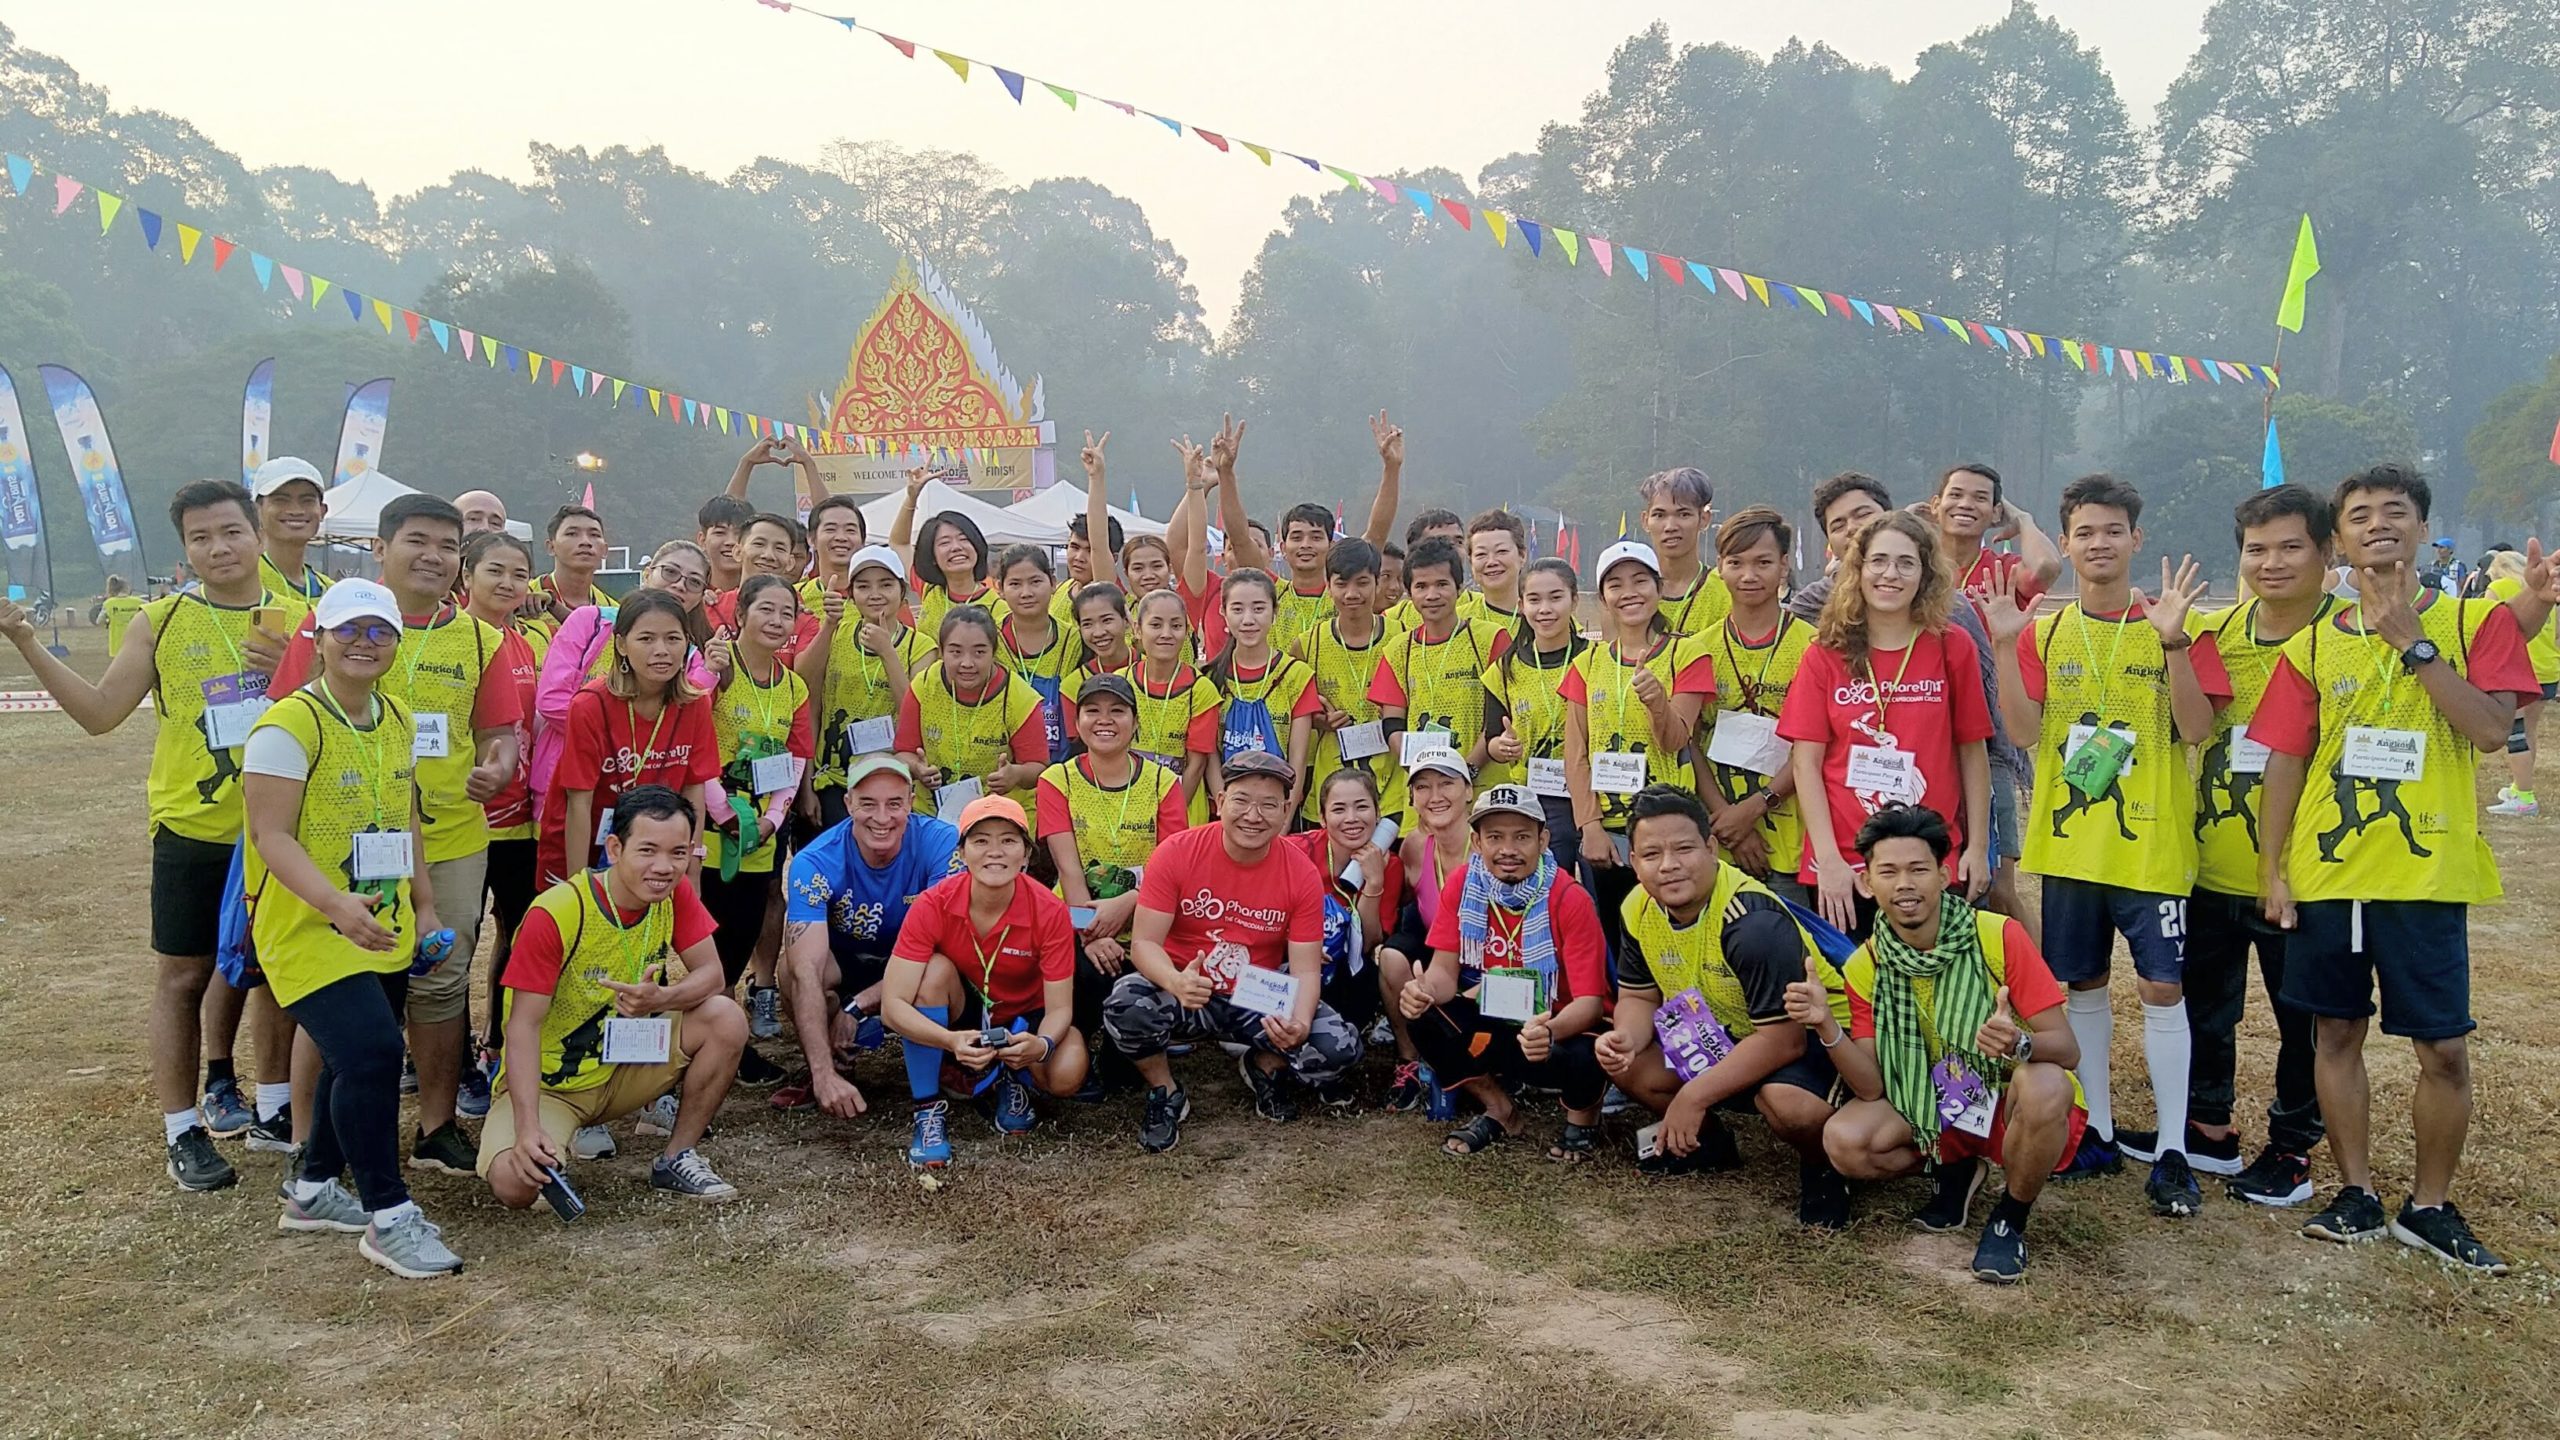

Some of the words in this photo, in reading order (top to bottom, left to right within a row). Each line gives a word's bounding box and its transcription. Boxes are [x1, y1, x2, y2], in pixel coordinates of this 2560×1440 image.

[853, 470, 896, 480] WELCOME
[985, 465, 1015, 477] FINISH
[1491, 788, 1518, 801] BTS
[1226, 900, 1263, 920] Phare
[1695, 1019, 1728, 1062] Angko
